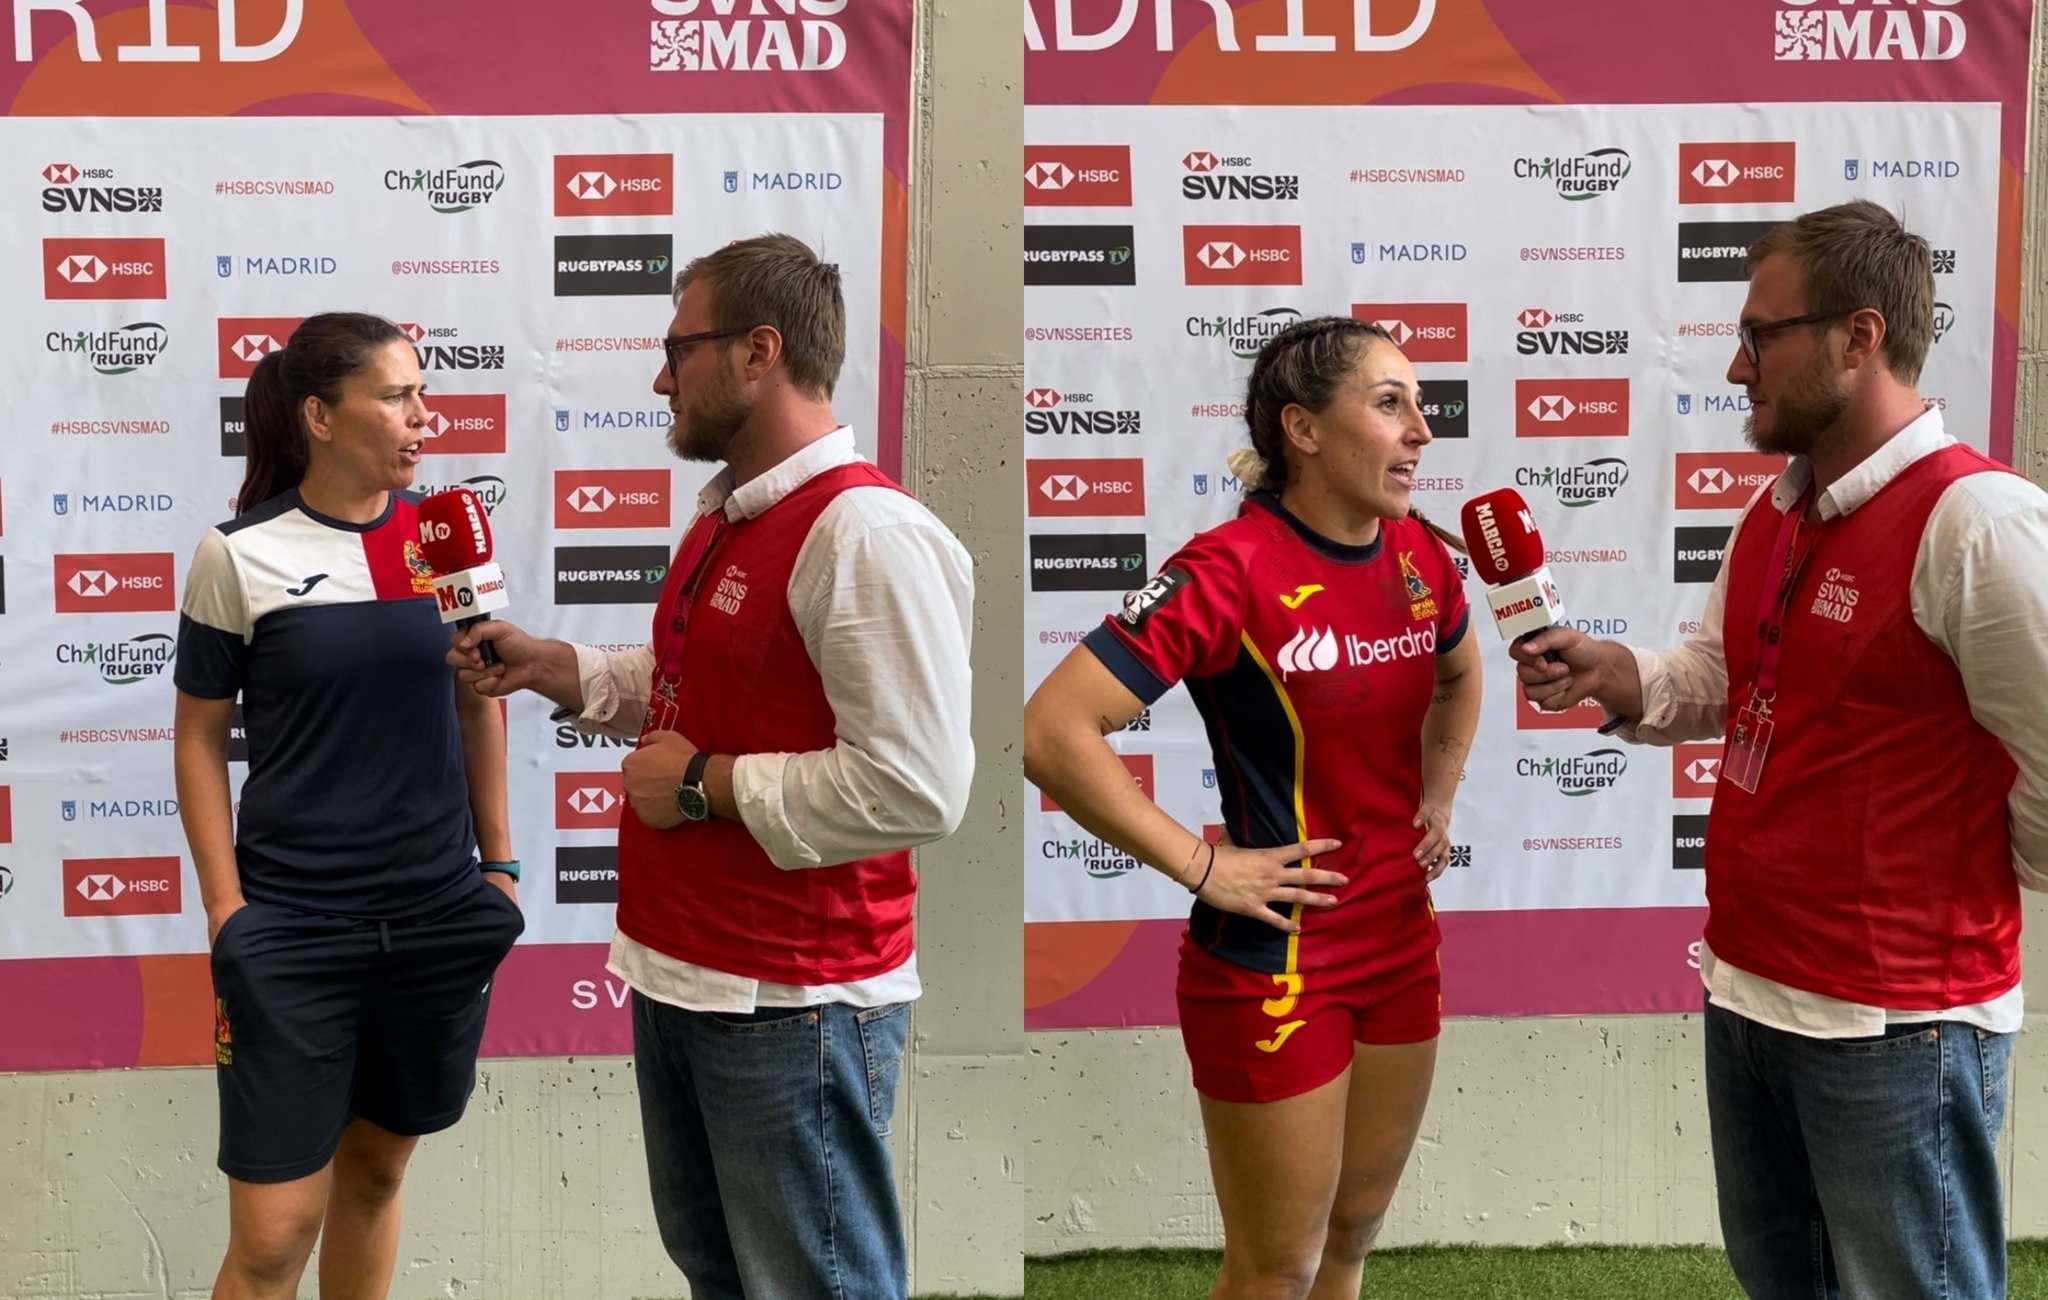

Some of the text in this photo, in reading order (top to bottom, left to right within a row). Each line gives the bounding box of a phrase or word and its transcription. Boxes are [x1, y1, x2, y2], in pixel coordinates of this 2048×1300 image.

[14, 0, 305, 62] RID
[1824, 10, 1967, 60] MAD
[701, 20, 847, 71] MAD
[1222, 157, 1251, 166] HSBC
[1514, 157, 1621, 180] ChildFund
[1873, 161, 1959, 177] MADRID
[83, 169, 113, 178] HSBC
[1079, 170, 1119, 182] HSBC
[1350, 169, 1465, 182] #HSBCSVNSMAD
[1744, 166, 1783, 178] HSBC
[215, 181, 334, 194] #HSBCSVNSMAD
[385, 168, 495, 192] ChildFund
[621, 179, 661, 191] HSBC
[753, 173, 841, 189] MADRID
[1183, 176, 1274, 199] SVNS
[1562, 178, 1619, 193] RUGBY
[43, 188, 137, 212] SVNS
[434, 189, 493, 205] RUGBY
[1024, 247, 1130, 264] RUGBYPASS TV
[1250, 249, 1289, 261] HSBC
[1380, 245, 1466, 261] MADRID
[1520, 247, 1625, 261] @SVNSSERIES
[1681, 246, 1748, 259] RUGBYPA
[112, 263, 153, 275] HSBC
[247, 258, 336, 274] MADRID
[392, 260, 499, 274] @SVNSSERIES
[558, 256, 669, 274] RUGBYPASS TV
[1555, 314, 1583, 322] HSBC
[428, 328, 457, 337] HSBC
[1025, 328, 1132, 341] @SVNSSERIES
[1417, 327, 1455, 338] HSBC
[1678, 323, 1742, 337] #HSBCS
[46, 331, 157, 353] ChildFund
[1235, 337, 1270, 350] RUG
[1517, 331, 1604, 355] SVNS
[97, 352, 156, 366] RUGBY
[418, 345, 480, 370] VNS
[1064, 394, 1093, 402] HSBC
[1704, 396, 1751, 411] MAD
[1191, 405, 1248, 417] #HSBCS
[1444, 401, 1464, 418] TV
[1579, 402, 1617, 413] HSBC
[454, 418, 494, 430] HSBC
[583, 411, 671, 428] MADRID
[1025, 411, 1117, 435] SVNS
[52, 421, 170, 434] #HSBCSVNSMAD
[1516, 466, 1619, 486] ChildFund
[1093, 482, 1132, 493] HSBC
[1409, 478, 1464, 491] SERIES
[1562, 486, 1617, 498] RUGBY
[83, 495, 172, 511] MADRID
[620, 493, 658, 504] HSBC
[465, 504, 487, 554] MARCA
[1475, 502, 1506, 560] MARCA
[1034, 554, 1143, 571] RUGBYPASS TV
[1545, 550, 1628, 563] BCSVNSMAD
[1678, 551, 1725, 561] RUGBY
[558, 567, 666, 582] RUGBYPASS TV
[122, 577, 162, 588] HSBC
[476, 580, 500, 595] MARCA
[717, 577, 748, 600] SVNS
[1818, 582, 1860, 607] SVNS
[718, 596, 741, 616] MAD
[1494, 598, 1534, 621] MARCA
[1823, 600, 1854, 623] MAD
[1345, 622, 1436, 666] Iberdrol
[56, 643, 167, 664] ChildFund
[106, 663, 165, 676] RUGBY
[60, 728, 176, 743] #HSBCSVNSMAD
[1516, 757, 1618, 777] ChildFund
[1562, 776, 1616, 788] RUGBY
[90, 799, 179, 818] MADRID
[1042, 840, 1130, 859] ChildFu
[1523, 837, 1622, 851] @SVNSSERIES
[1089, 859, 1144, 871] RUGBY
[559, 869, 619, 882] RUGBYP
[130, 880, 169, 892] HSBC
[571, 980, 631, 1010] SV
